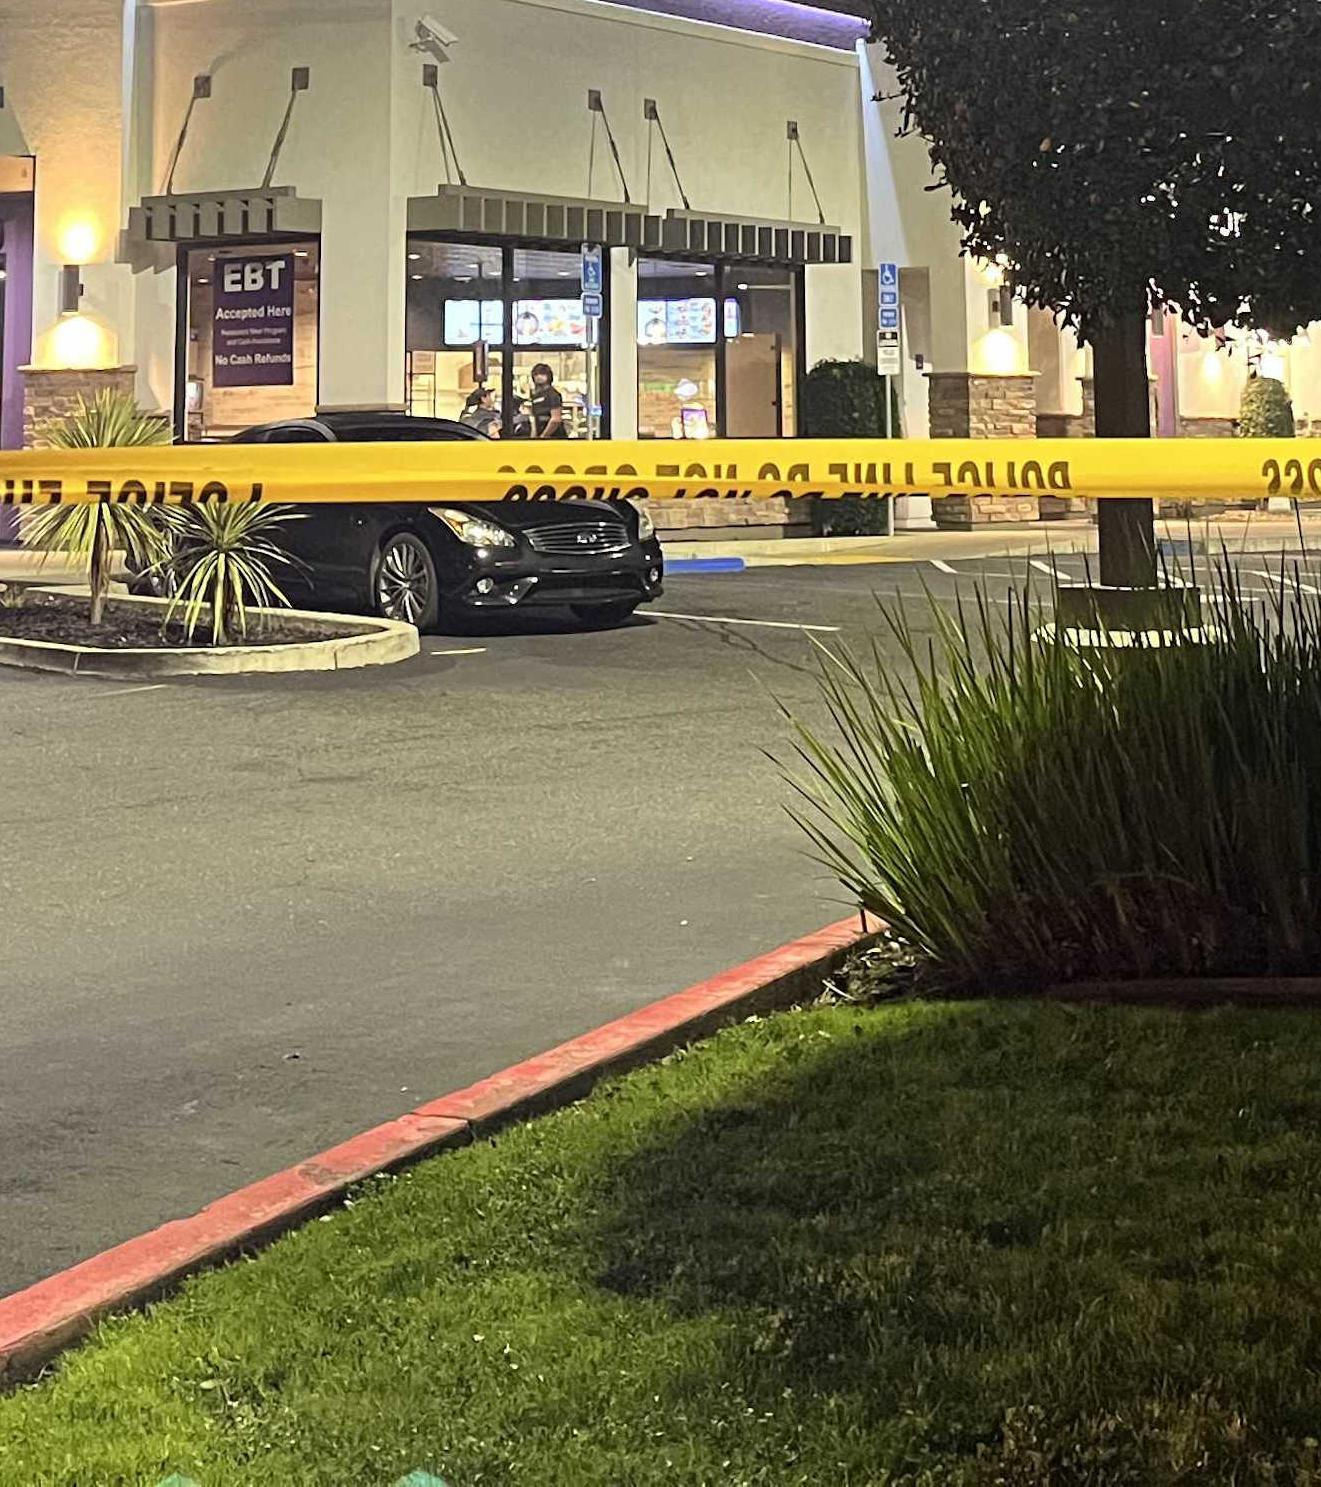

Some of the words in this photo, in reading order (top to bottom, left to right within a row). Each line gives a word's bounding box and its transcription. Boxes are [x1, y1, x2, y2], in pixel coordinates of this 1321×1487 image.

[223, 260, 286, 292] EBT
[215, 306, 265, 321] Accepted
[266, 305, 292, 317] Here
[214, 355, 228, 366] No
[229, 354, 253, 365] Cash
[253, 353, 292, 364] Refunds
